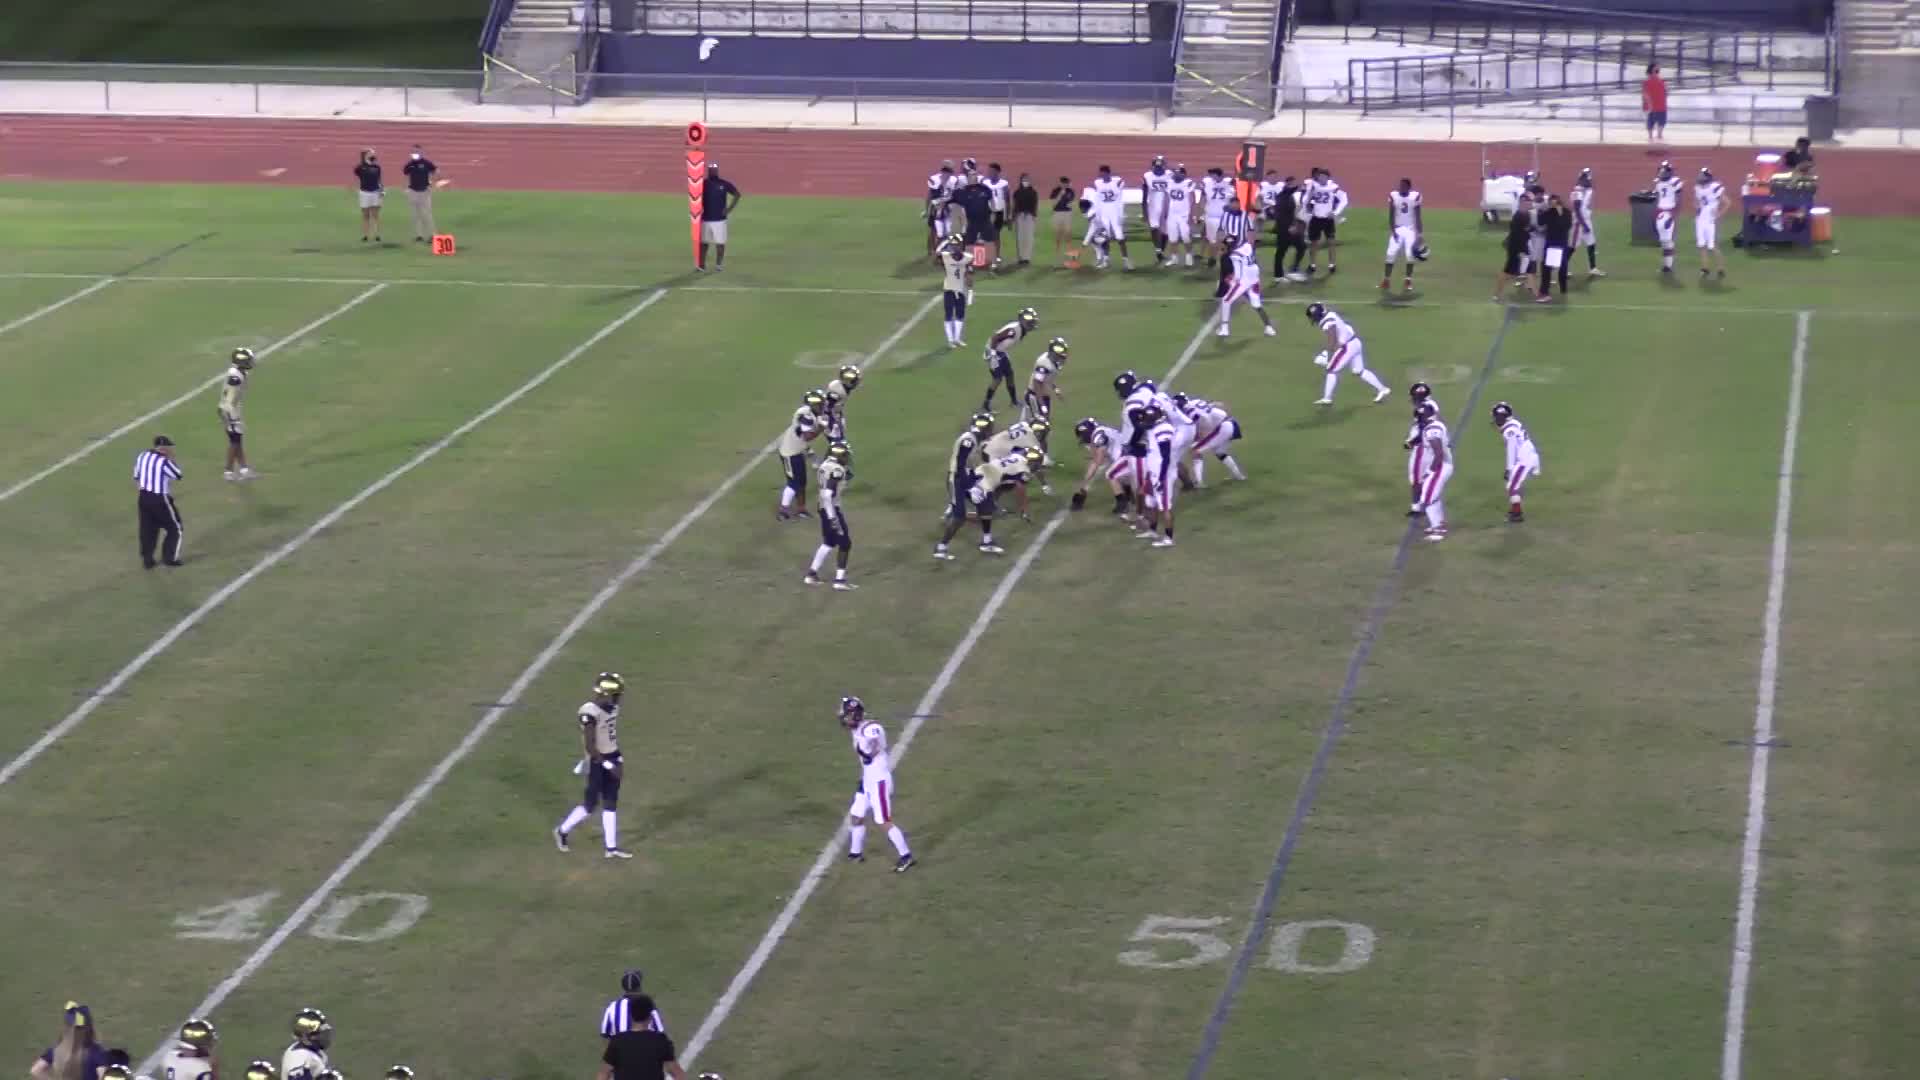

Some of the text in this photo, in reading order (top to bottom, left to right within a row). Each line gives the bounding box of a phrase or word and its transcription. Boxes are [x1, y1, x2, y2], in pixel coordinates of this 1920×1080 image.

[1246, 146, 1257, 168] 1
[172, 890, 428, 942] 40
[1116, 914, 1377, 973] 50
